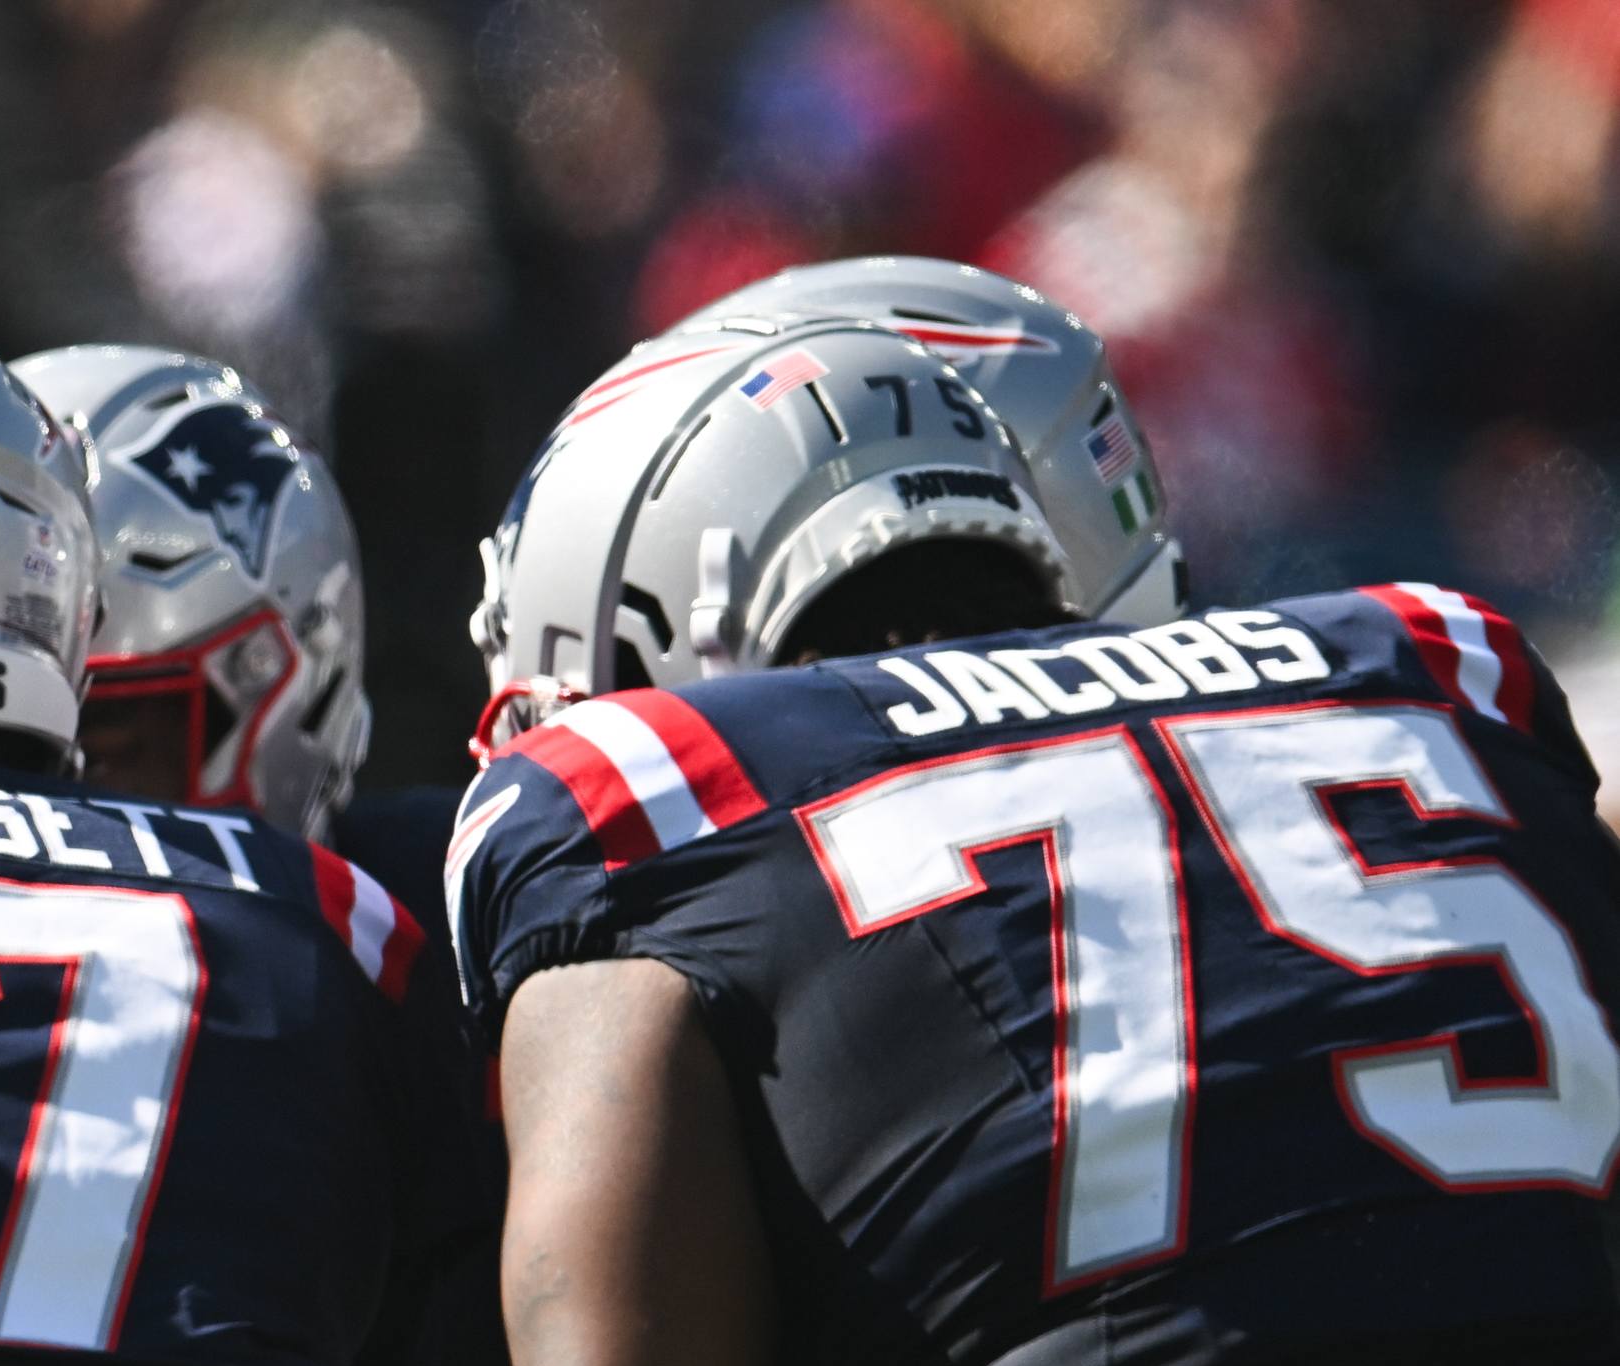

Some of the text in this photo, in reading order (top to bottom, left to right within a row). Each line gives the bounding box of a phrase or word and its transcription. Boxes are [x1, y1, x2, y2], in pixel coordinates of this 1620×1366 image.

[864, 375, 986, 440] 75
[877, 610, 1331, 737] JACOBS
[793, 698, 1620, 1299] 75
